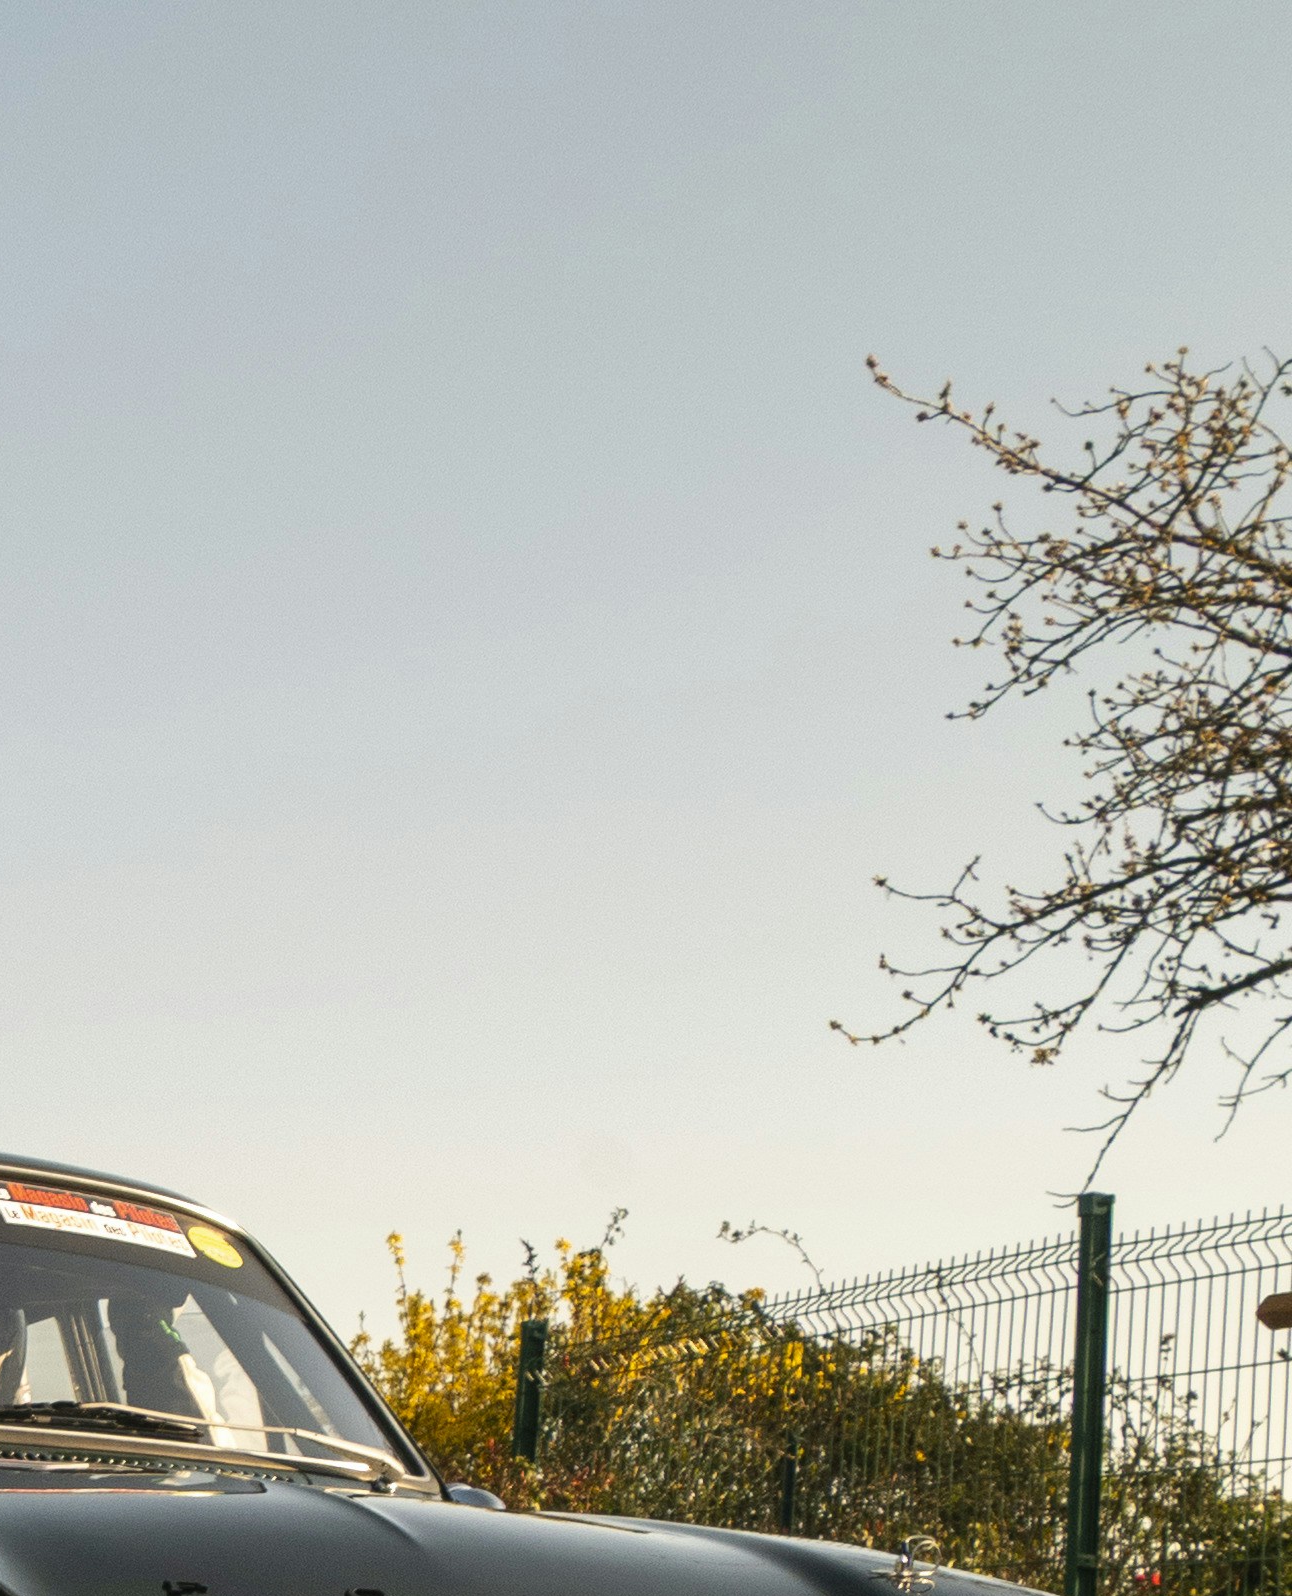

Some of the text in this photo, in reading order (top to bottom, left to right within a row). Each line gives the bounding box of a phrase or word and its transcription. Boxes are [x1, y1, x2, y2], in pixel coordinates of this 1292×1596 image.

[8, 1182, 90, 1212] Magasin
[112, 1200, 181, 1233] Pilotes
[20, 1204, 99, 1231] Magasin
